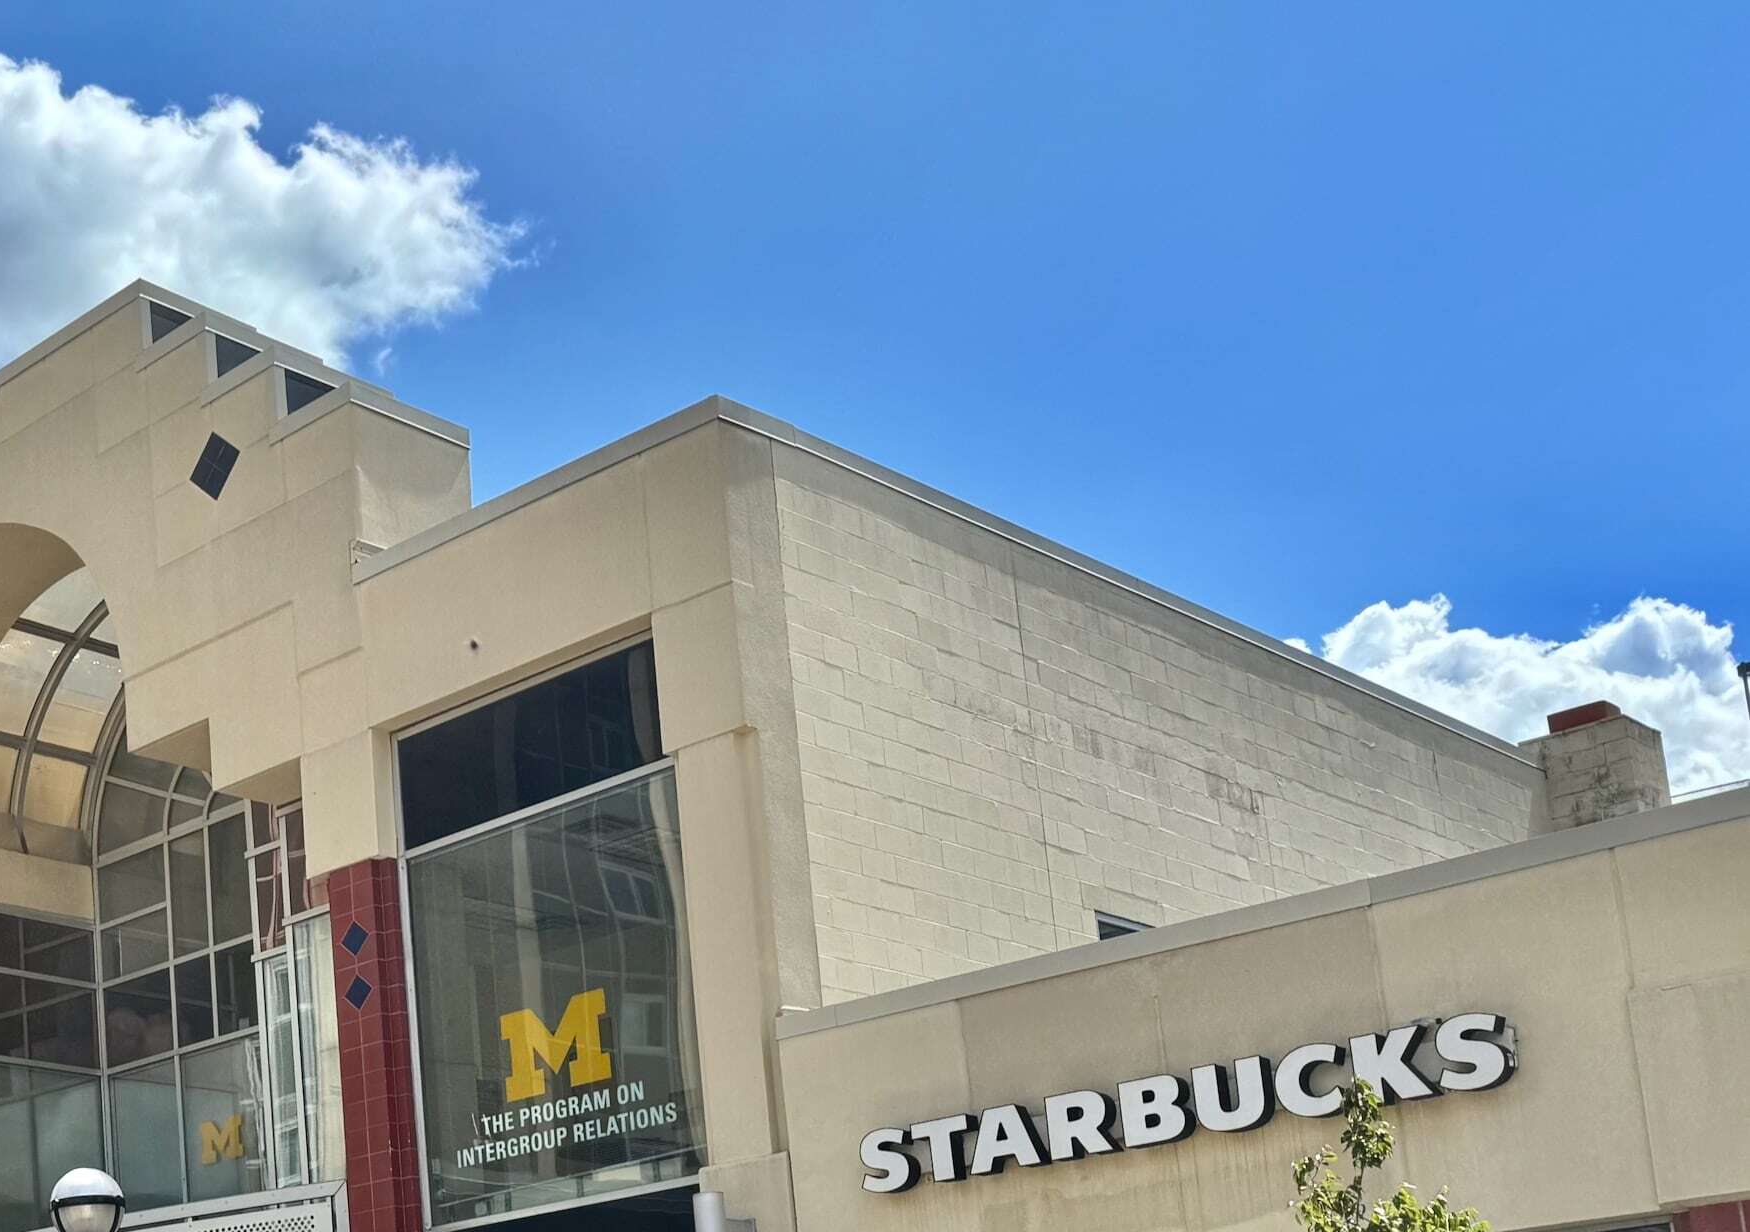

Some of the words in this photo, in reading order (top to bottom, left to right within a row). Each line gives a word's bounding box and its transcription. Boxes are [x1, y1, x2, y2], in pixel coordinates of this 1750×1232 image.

[500, 987, 613, 1103] M
[456, 1127, 568, 1169] INTERGROUP
[573, 1102, 678, 1144] RELATIONS
[481, 1111, 515, 1138] THE
[519, 1088, 611, 1127] PROGRAM
[617, 1080, 645, 1106] ON
[859, 1012, 1510, 1194] STARBUCKS
